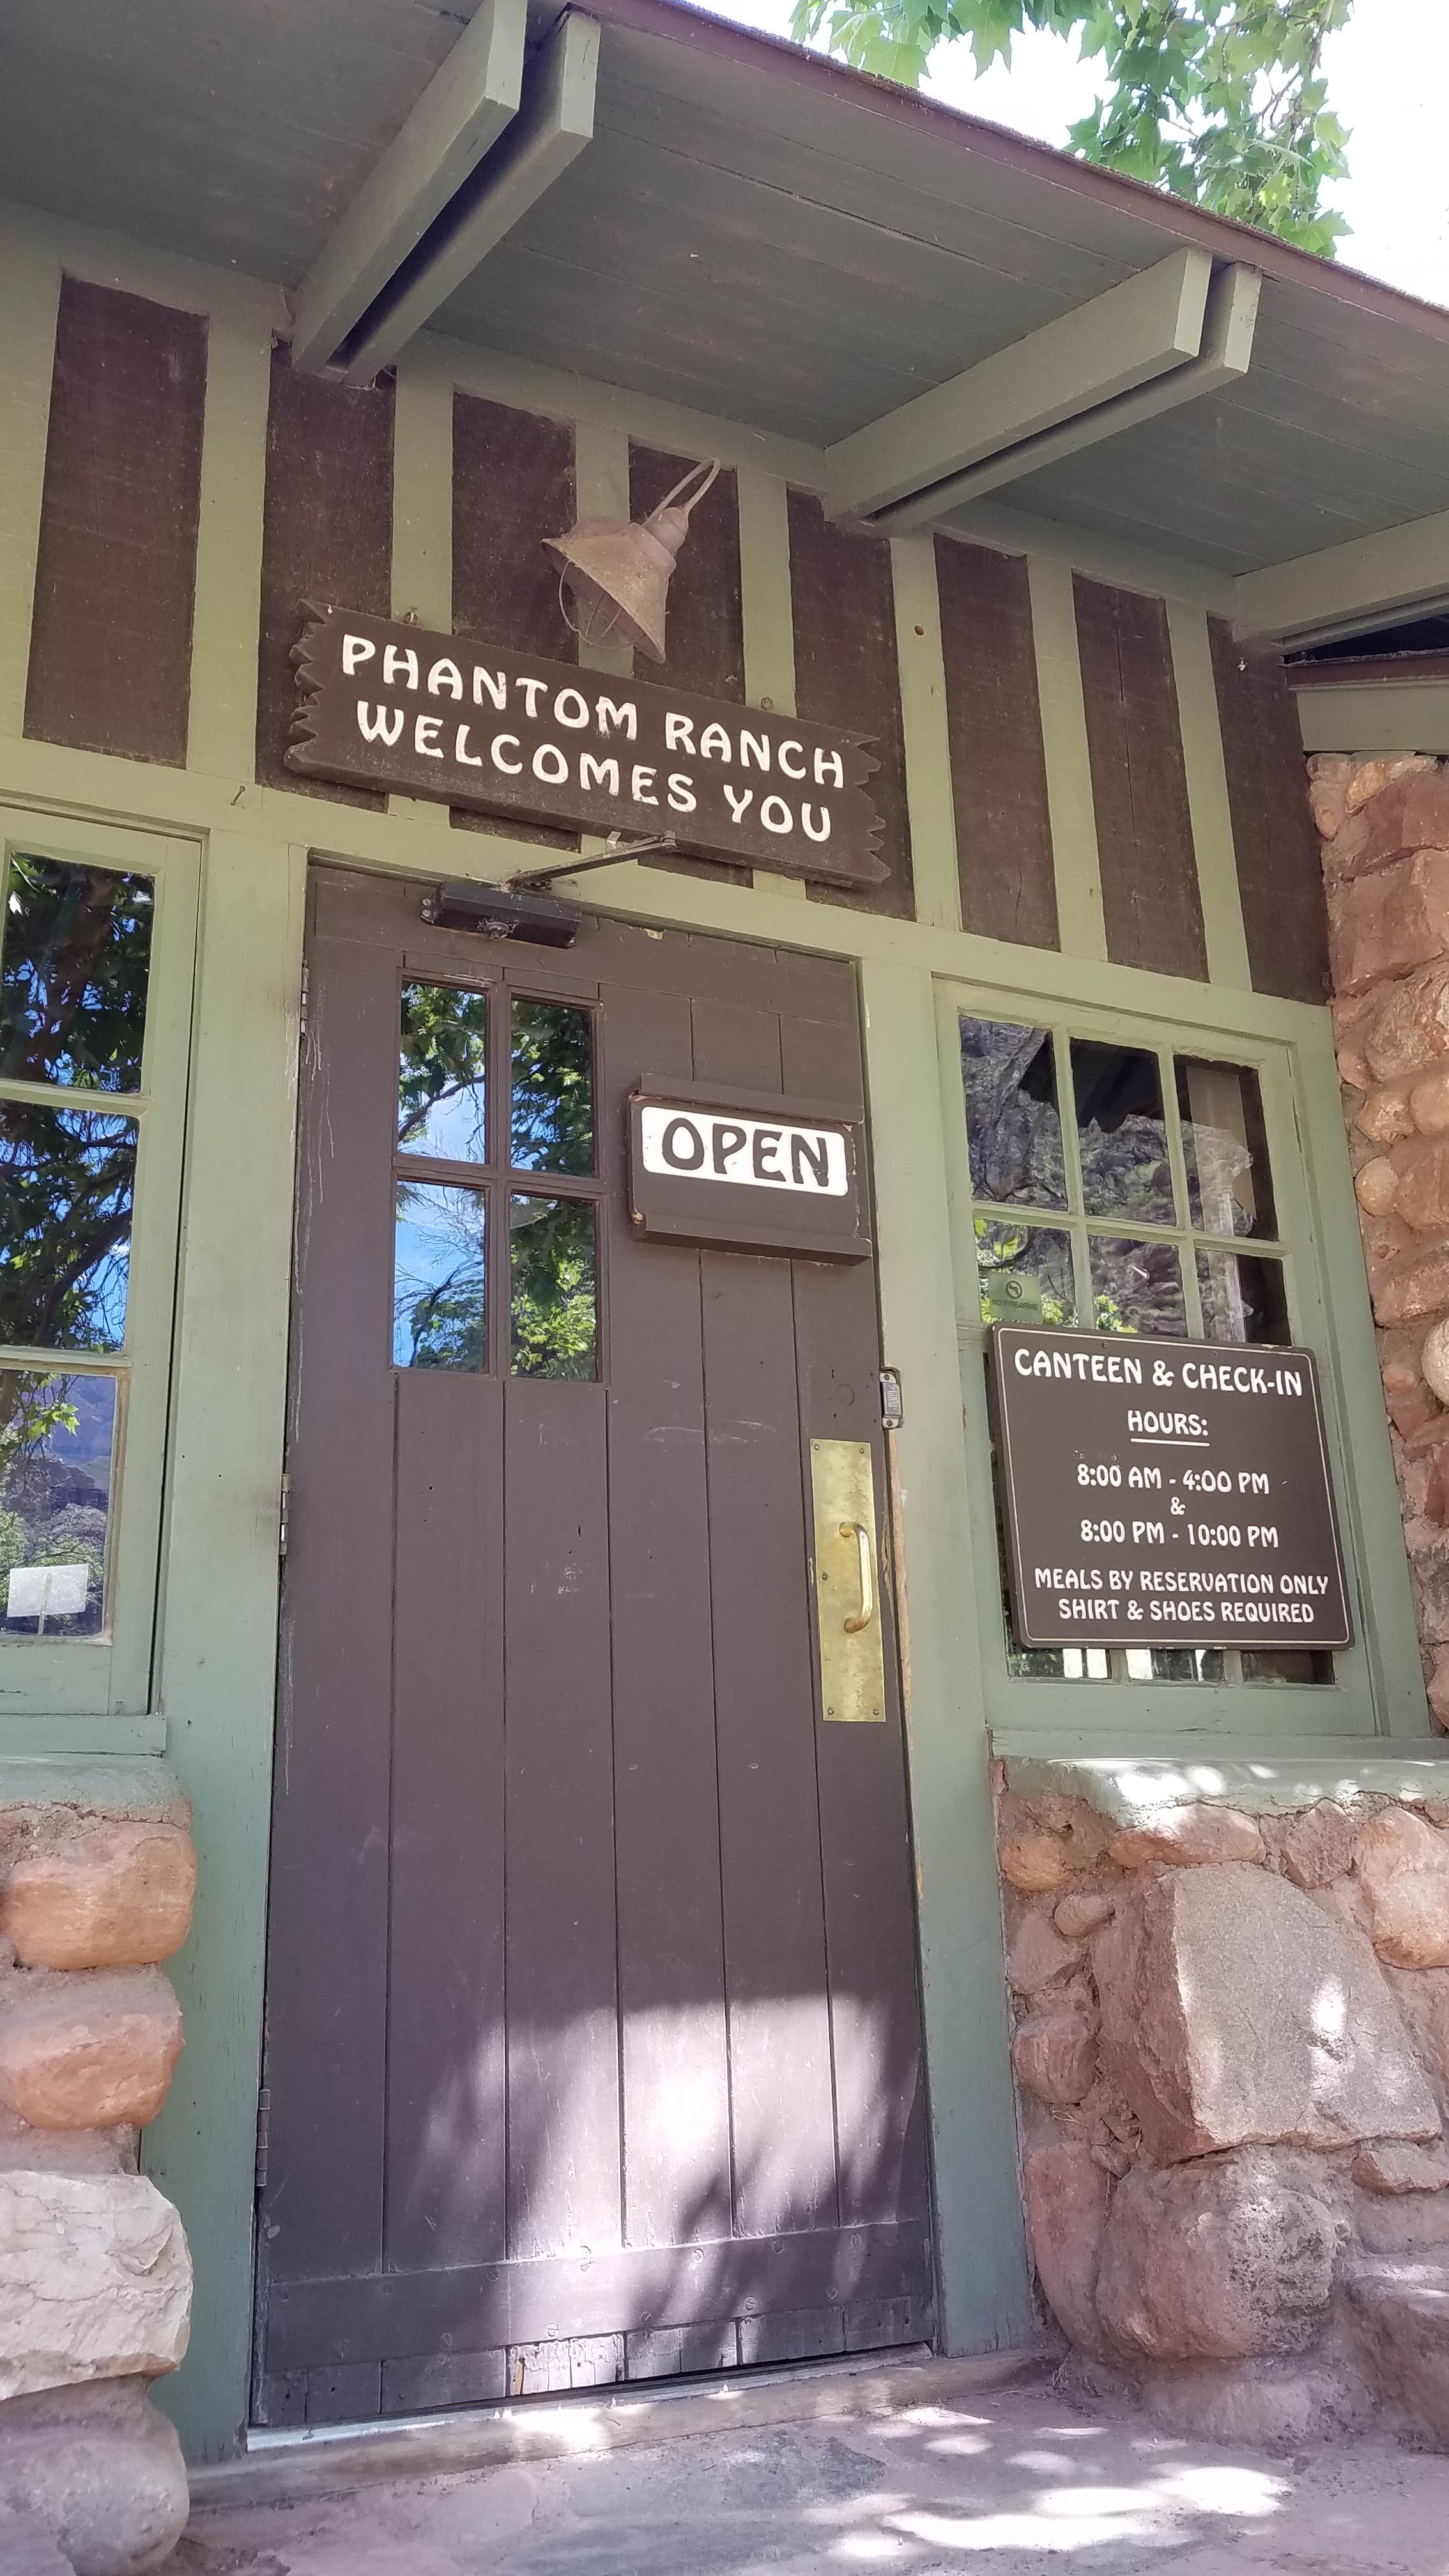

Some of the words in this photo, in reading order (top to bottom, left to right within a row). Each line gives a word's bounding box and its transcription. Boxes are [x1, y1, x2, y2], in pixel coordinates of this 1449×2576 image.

[342, 633, 638, 741] PHANTOM
[664, 711, 844, 789] RANCH
[356, 700, 697, 813] WELCOMES
[723, 783, 831, 843] YOU
[662, 1117, 829, 1187] OPEN
[1014, 1347, 1143, 1385] CANTEEN
[1151, 1359, 1176, 1388] &
[1181, 1361, 1303, 1397] CHECK-IN
[1127, 1409, 1209, 1437] HOURS:
[1077, 1463, 1123, 1488] 8:00
[1128, 1465, 1162, 1490] AM
[1182, 1469, 1232, 1494] 4:00
[1238, 1471, 1270, 1495] PM
[1170, 1496, 1186, 1516] &
[1080, 1519, 1126, 1544] 8:00
[1131, 1520, 1165, 1545] PM
[1186, 1522, 1241, 1547] 10:00
[1246, 1525, 1279, 1549] PM
[1034, 1567, 1104, 1591] MEALS
[1108, 1569, 1134, 1591] BY
[1139, 1570, 1275, 1594] RESERVATION
[1279, 1574, 1329, 1595] ONLY
[1058, 1597, 1121, 1620] SHIRT
[1126, 1599, 1145, 1621] &
[1149, 1599, 1216, 1622] SHOES
[1220, 1601, 1315, 1623] REQUIRED
